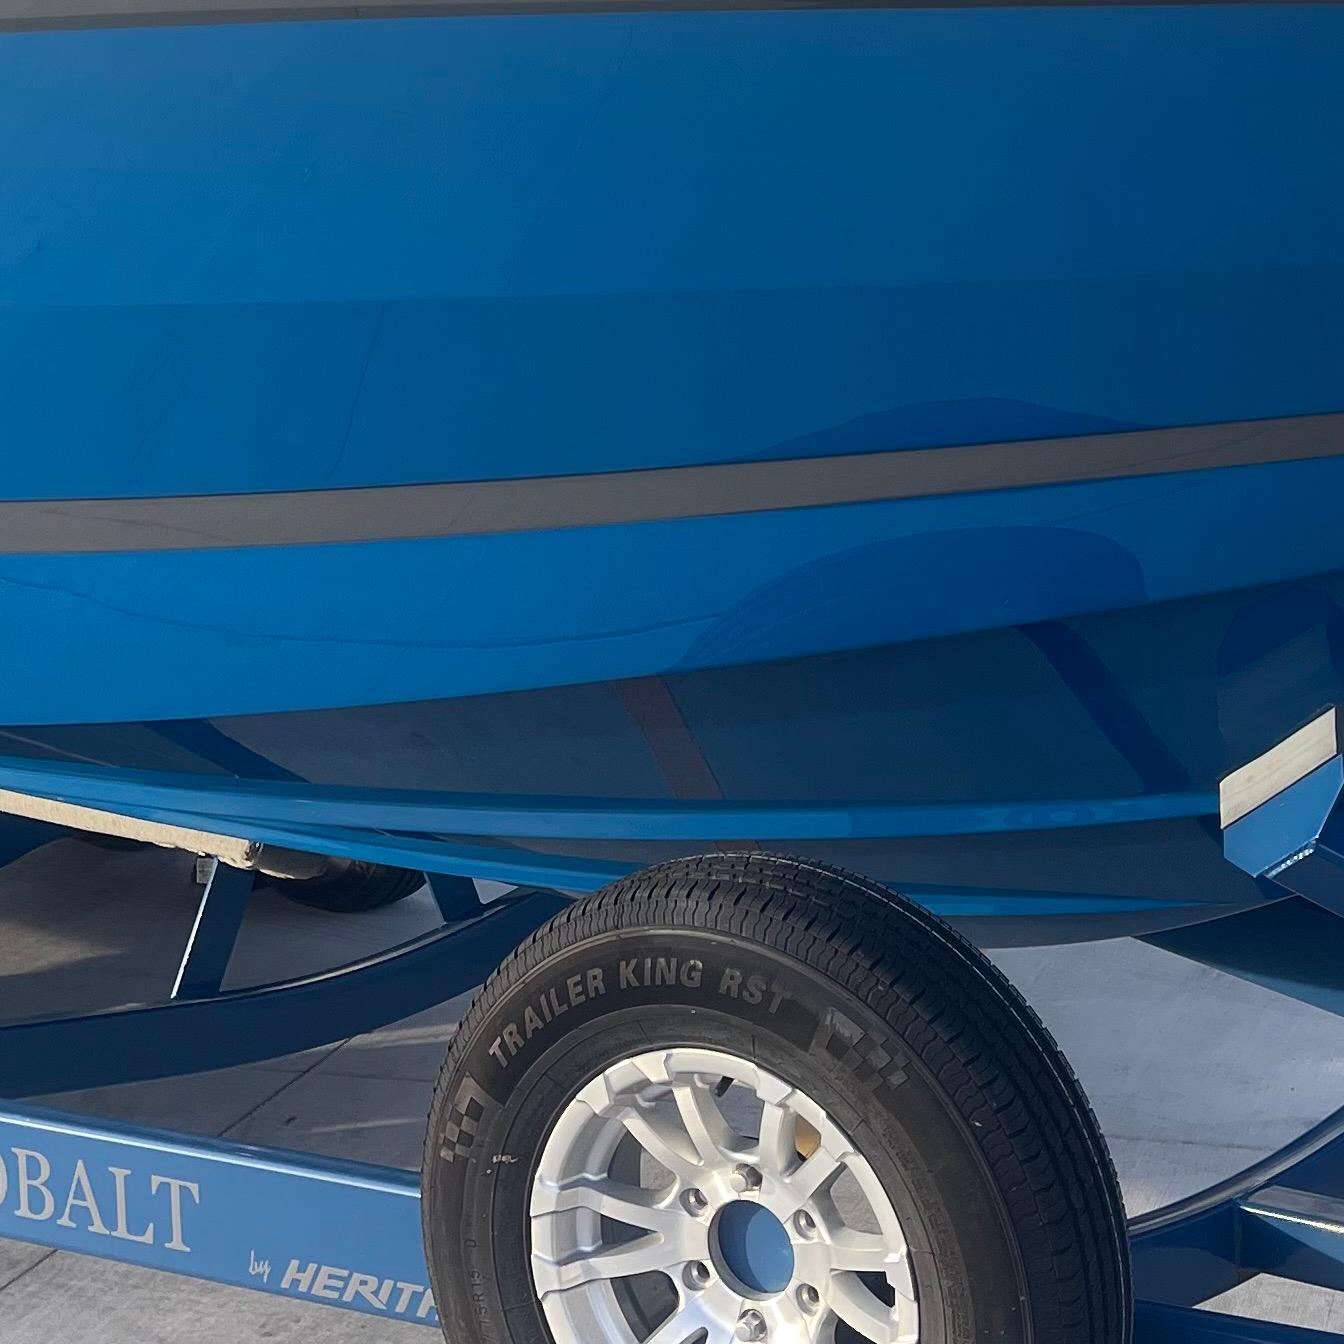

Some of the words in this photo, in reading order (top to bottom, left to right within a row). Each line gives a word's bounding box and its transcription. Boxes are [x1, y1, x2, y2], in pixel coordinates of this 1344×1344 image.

[488, 967, 606, 1069] TRAILER
[619, 957, 704, 990] KING
[718, 967, 788, 1015] RST
[248, 1249, 272, 1285] by
